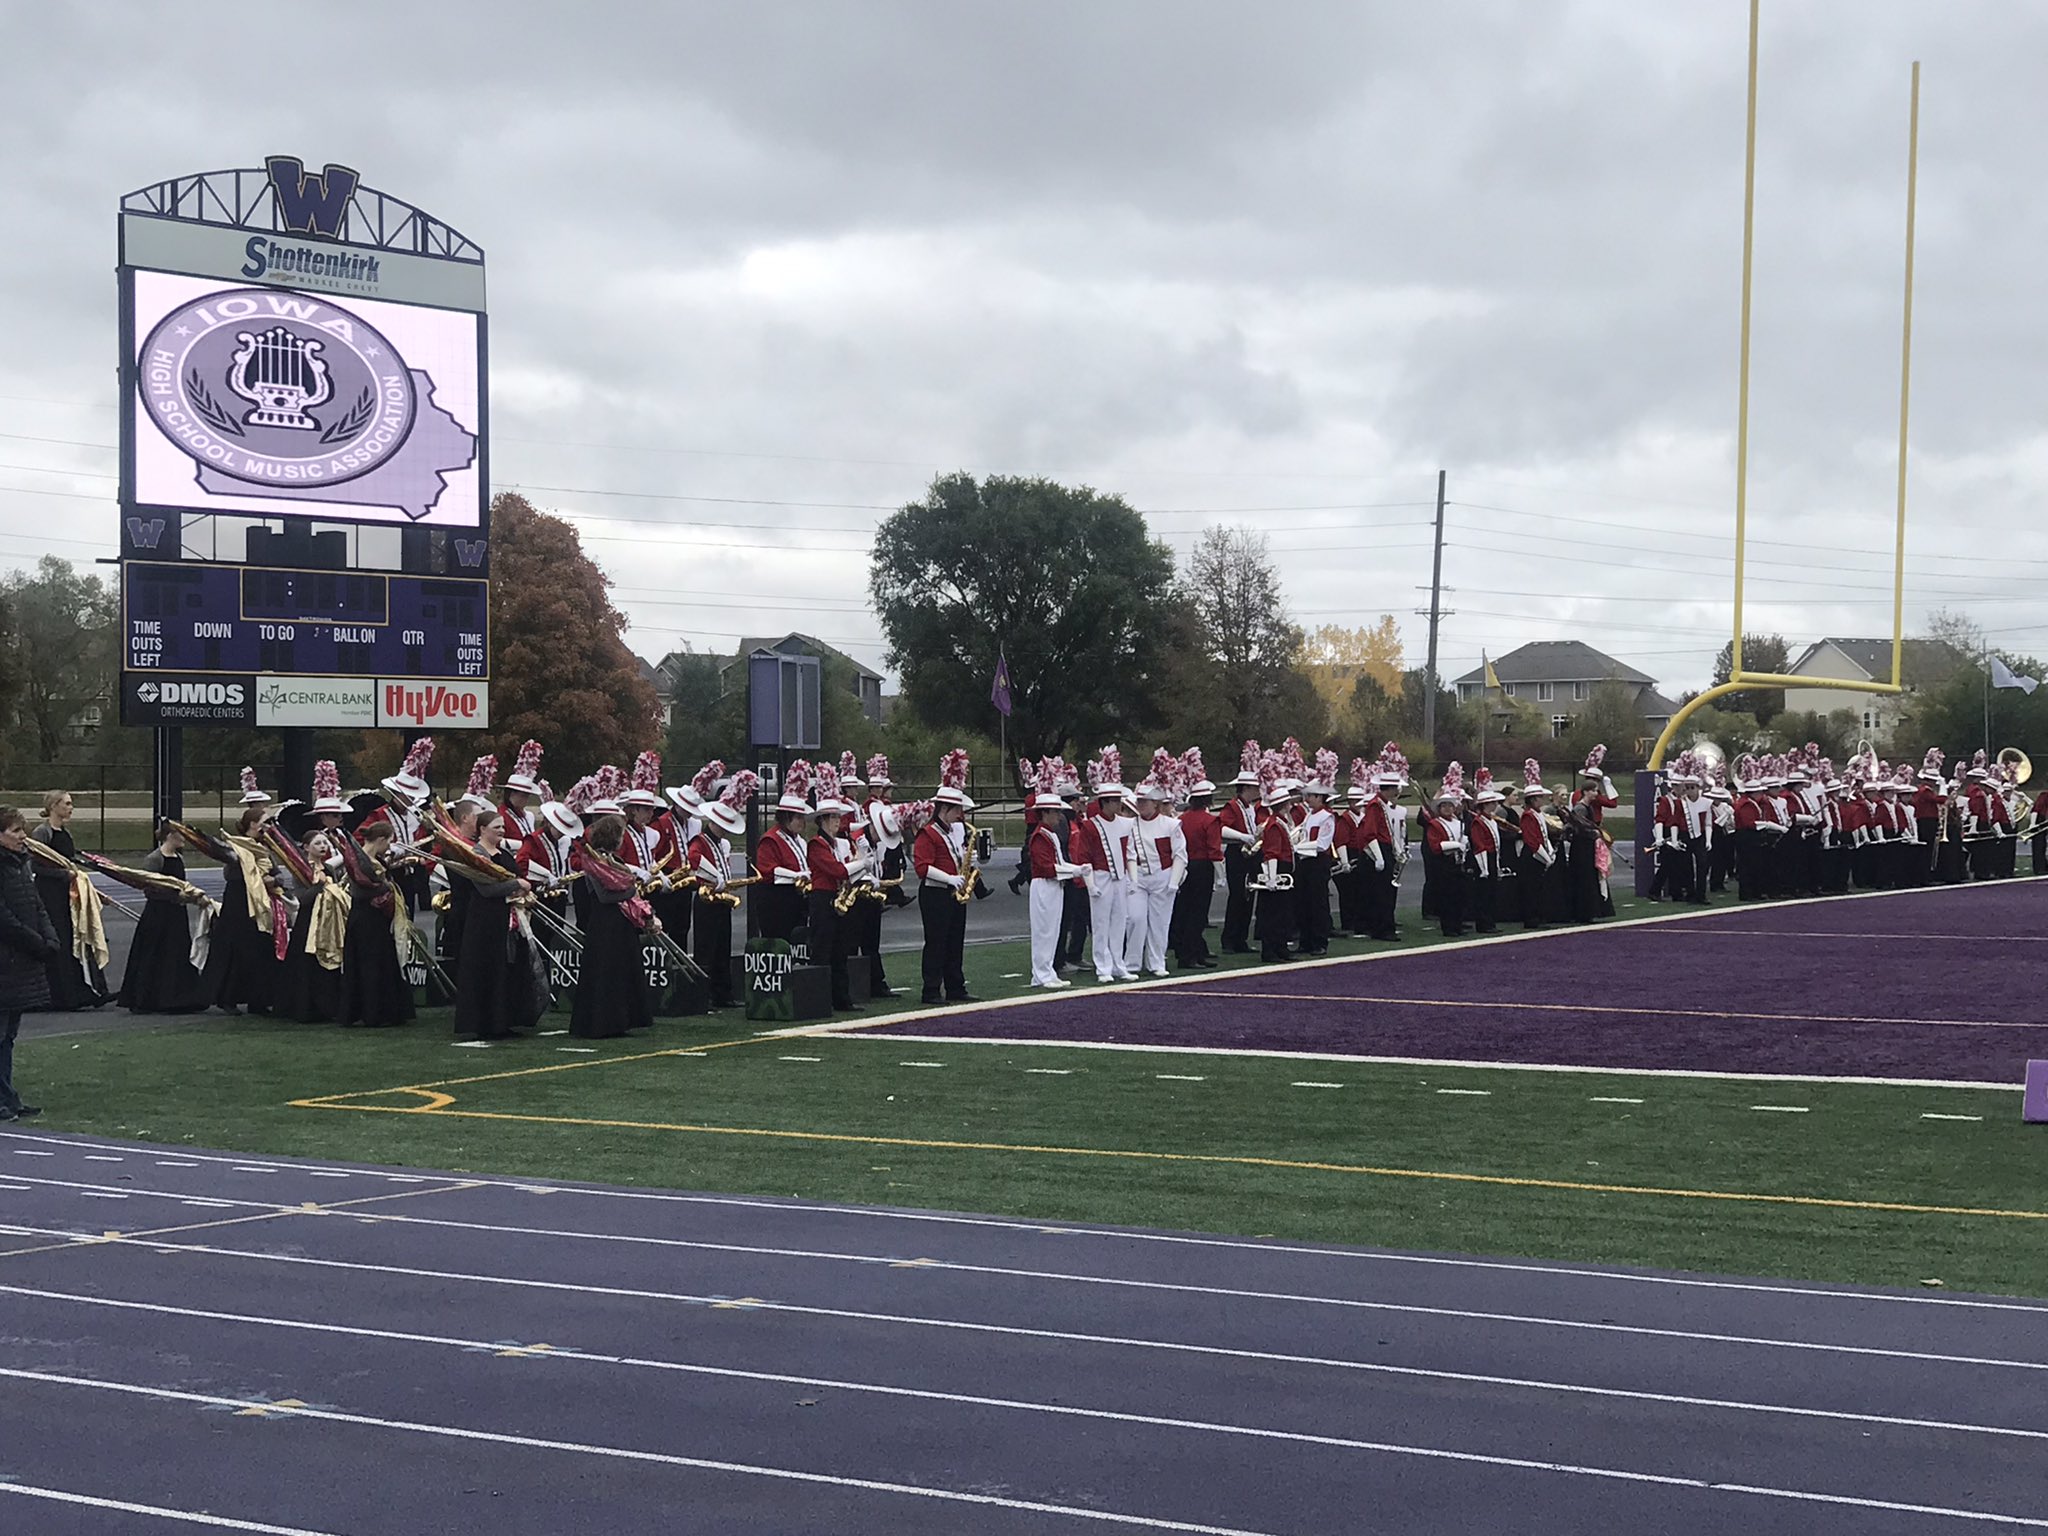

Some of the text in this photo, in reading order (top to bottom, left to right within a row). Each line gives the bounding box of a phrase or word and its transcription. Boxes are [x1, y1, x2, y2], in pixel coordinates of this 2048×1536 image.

[265, 156, 360, 239] W
[241, 236, 380, 282] Shottenkirk
[195, 296, 354, 342] IOWA
[151, 349, 404, 478] HIGH SCHOOL MUSIC ASSOCIATION
[127, 517, 165, 549] W
[454, 539, 487, 568] W
[133, 621, 161, 634] TIME
[194, 622, 232, 638] DOWN
[259, 625, 295, 641] TO GO
[333, 627, 376, 643] BALL ON
[132, 637, 163, 651] OUTS
[402, 630, 425, 645] QTR
[459, 633, 482, 646] TIME
[134, 653, 161, 667] LEFT
[457, 648, 483, 660] OUTS
[459, 663, 482, 675] LEFT
[160, 682, 245, 705] DMOS
[288, 692, 373, 705] CENTRAL BANK
[161, 706, 245, 718] ORTHOPAEDIC CENTERS
[642, 946, 667, 967] STY
[744, 952, 792, 974] DUSTIN
[753, 974, 782, 992] ASH
